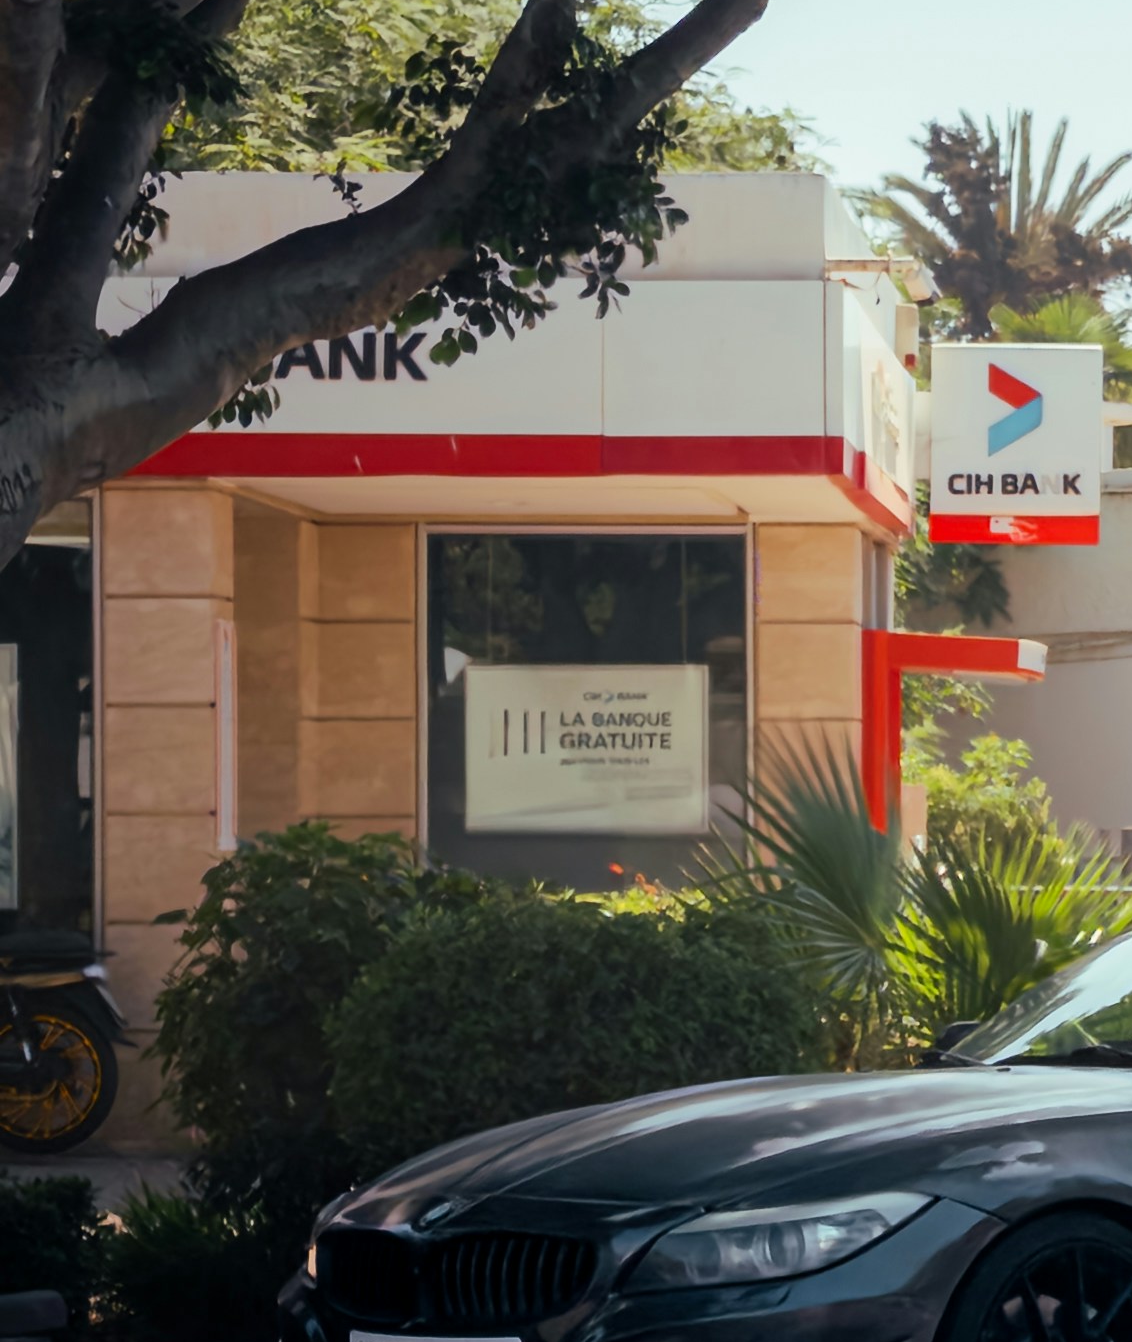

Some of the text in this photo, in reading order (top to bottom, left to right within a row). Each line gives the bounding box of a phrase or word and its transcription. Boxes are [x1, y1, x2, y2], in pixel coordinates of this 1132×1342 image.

[274, 331, 428, 381] ANK
[947, 473, 993, 495] CIH
[560, 711, 672, 728] LA BANQUE
[559, 732, 672, 750] GRATUITE
